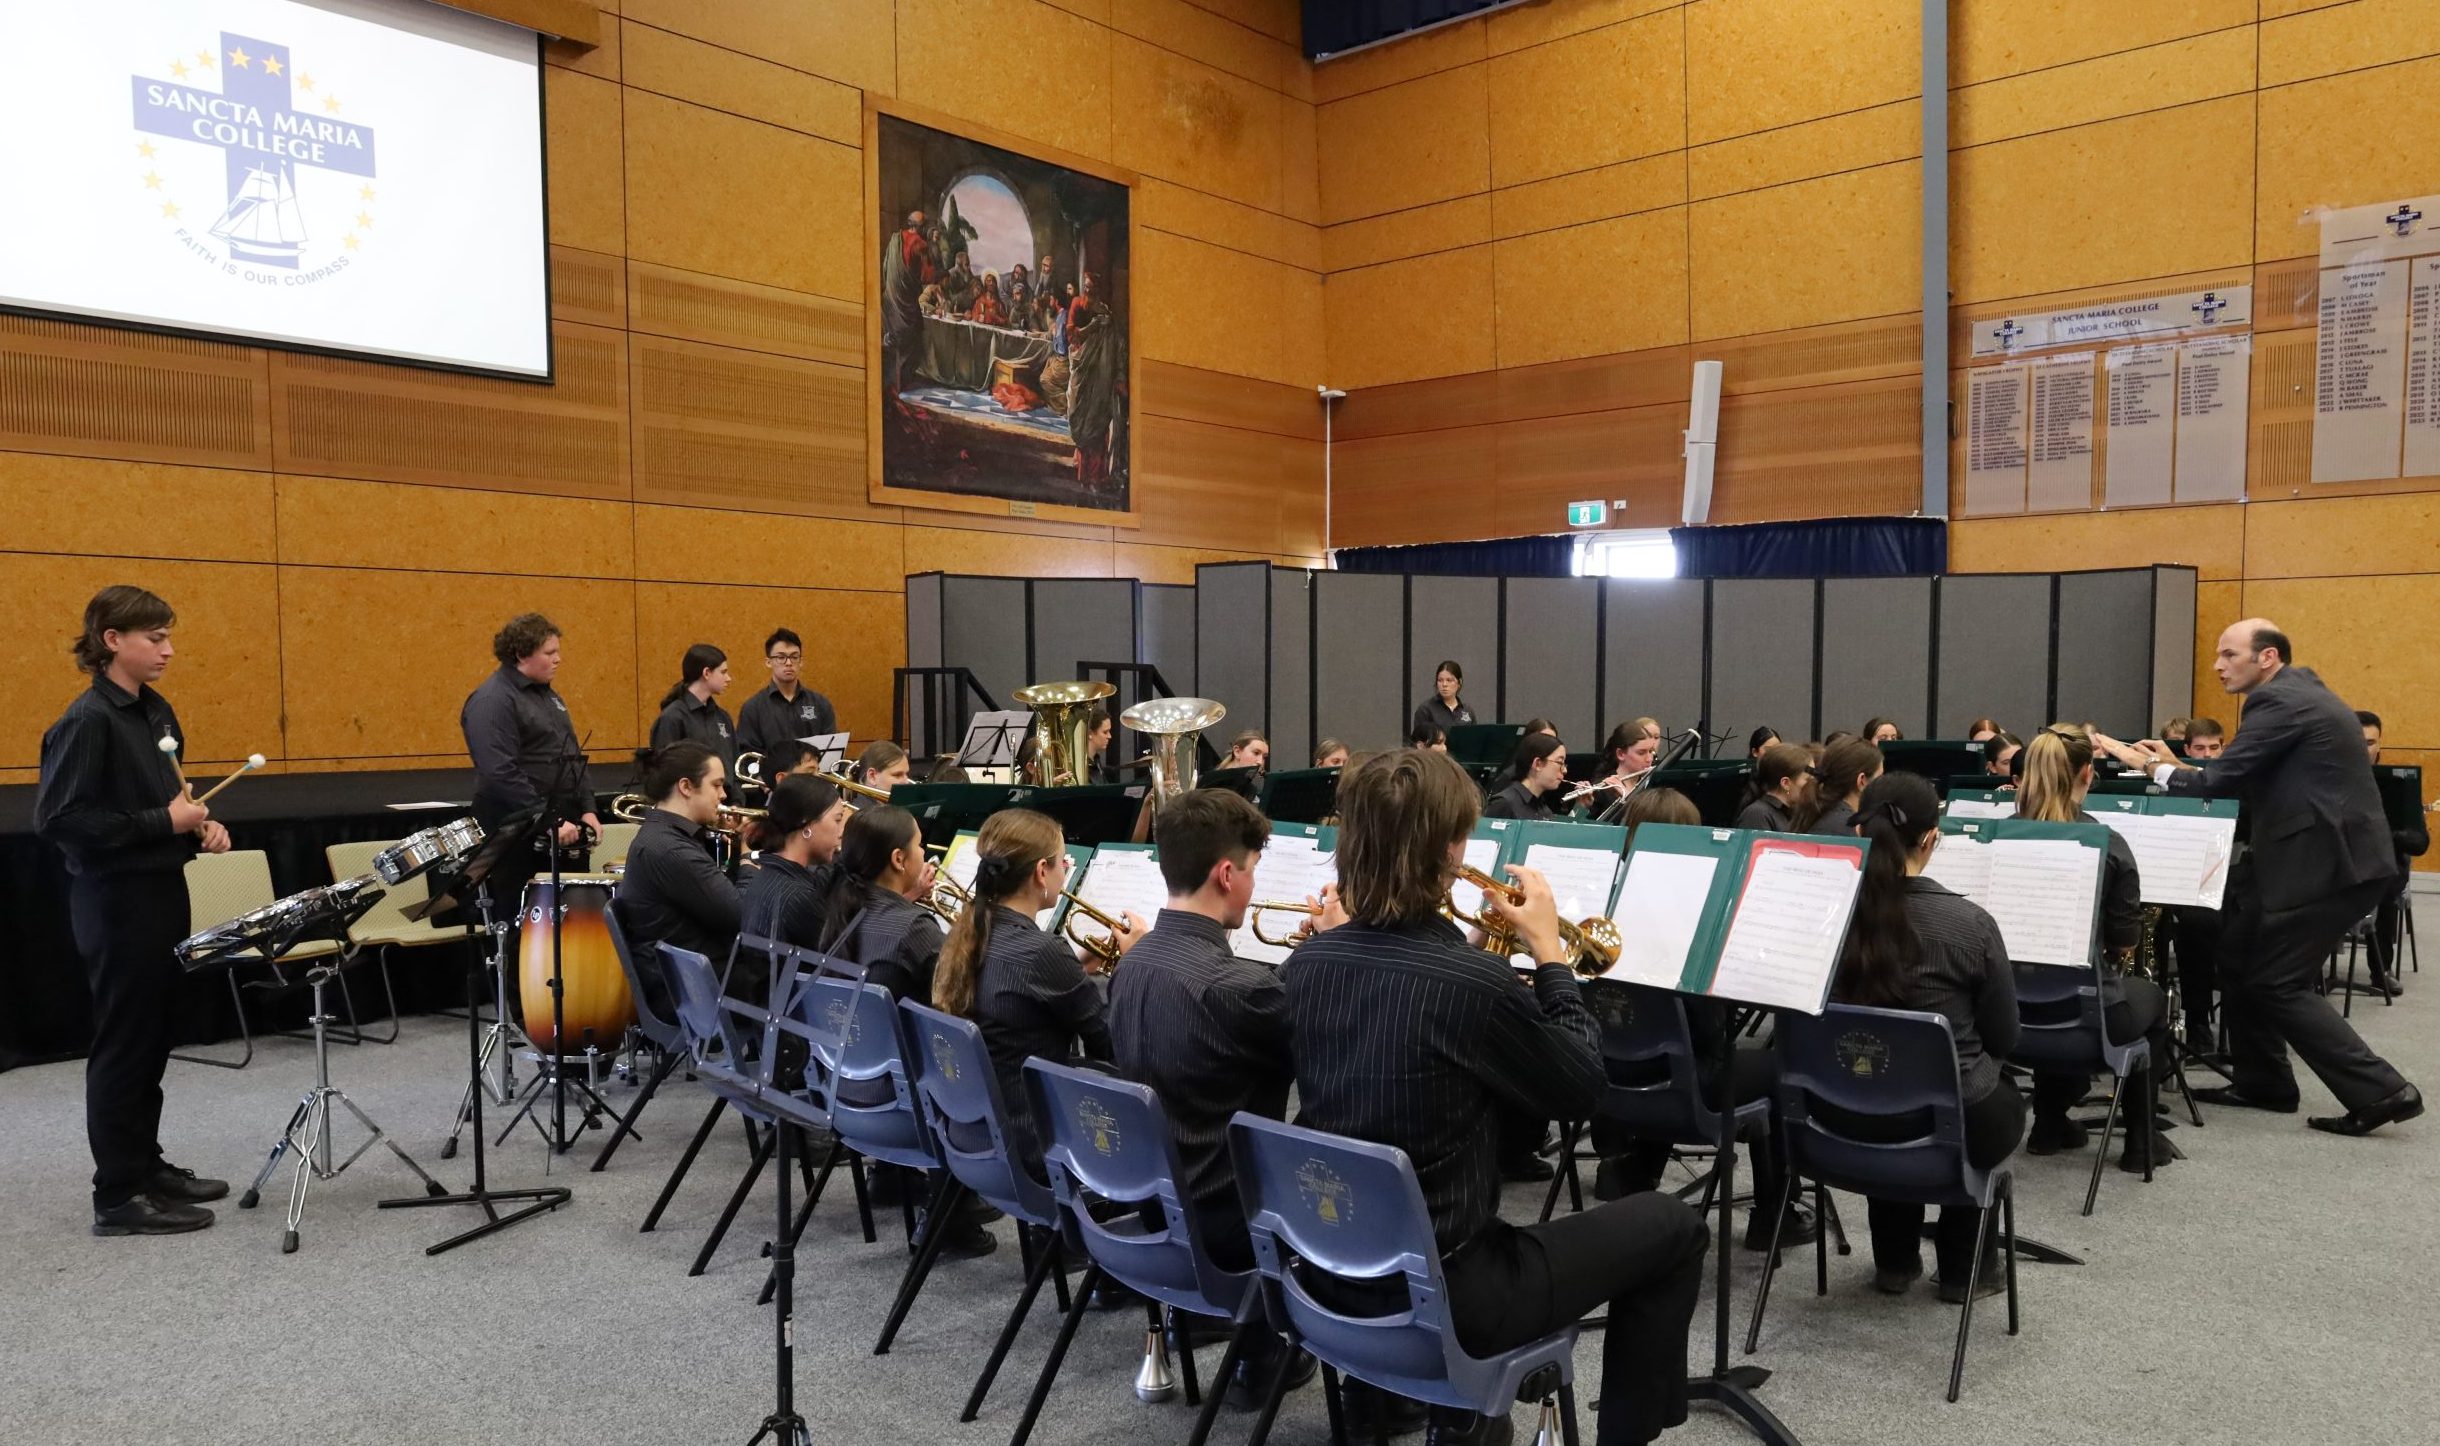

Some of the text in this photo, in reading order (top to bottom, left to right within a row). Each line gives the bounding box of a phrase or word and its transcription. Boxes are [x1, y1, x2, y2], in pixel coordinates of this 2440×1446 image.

[147, 84, 363, 150] SANCTA MARIA
[192, 118, 325, 163] COLLEGE
[174, 227, 350, 287] FAITH IS OUR COMPASS
[2343, 272, 2385, 282] Sportsman
[2052, 303, 2160, 325] SANCTA MARIA COLLEGE
[2068, 318, 2142, 335] JUNIOR SCHOOL
